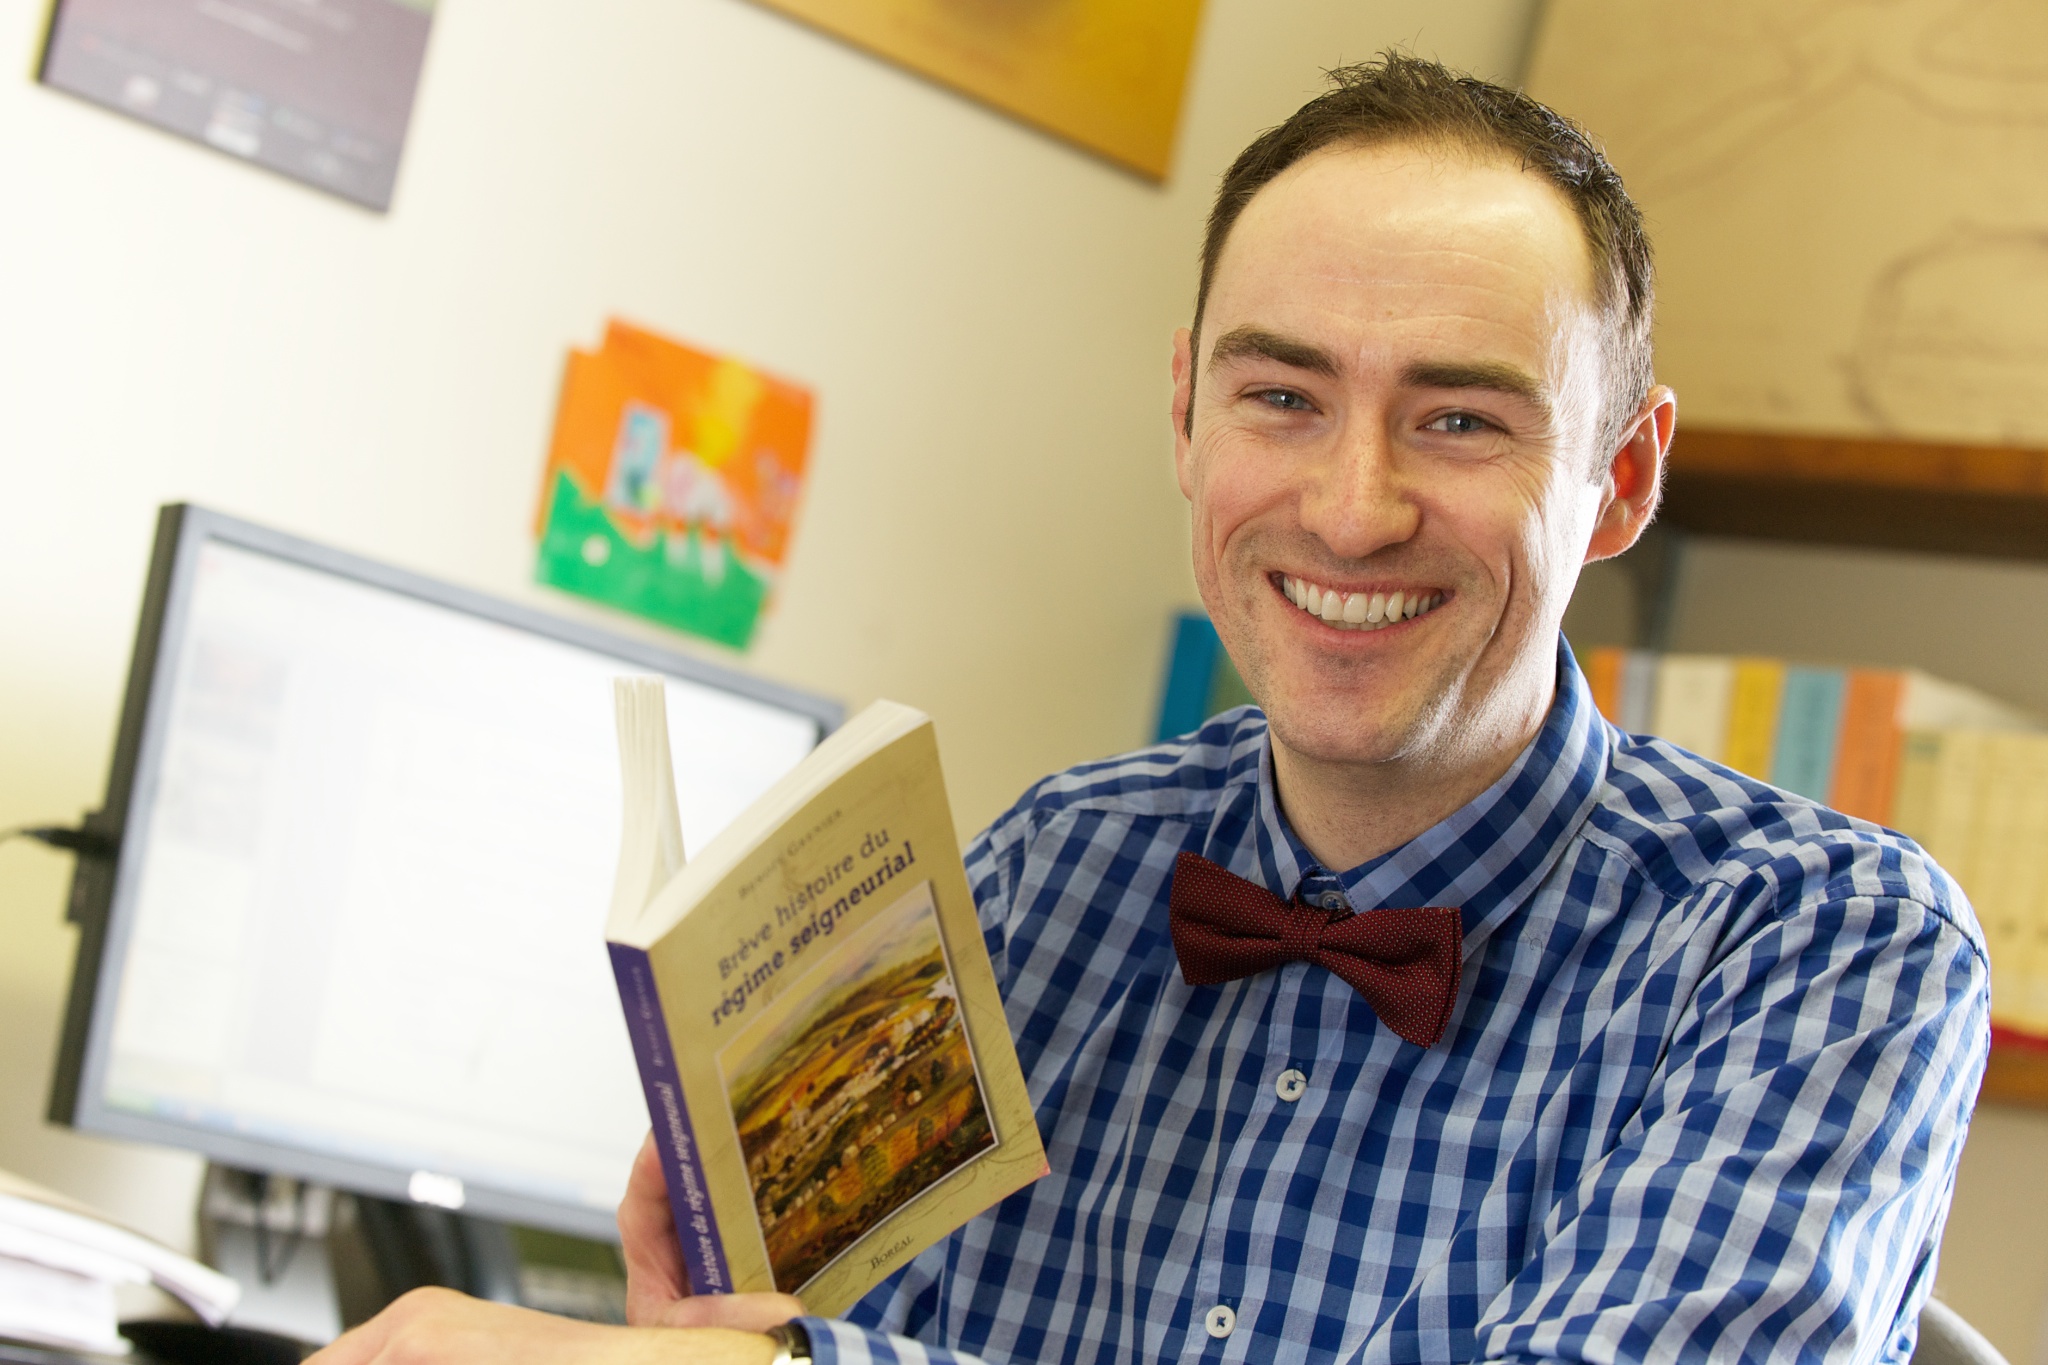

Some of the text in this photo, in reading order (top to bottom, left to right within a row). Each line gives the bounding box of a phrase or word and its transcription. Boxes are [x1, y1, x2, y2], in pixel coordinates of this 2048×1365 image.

[711, 950, 785, 1027] régime
[789, 839, 916, 957] seigneurial
[717, 828, 891, 980] Brève histoire du
[654, 1081, 691, 1162] seigneurial
[699, 1235, 723, 1287] histoire
